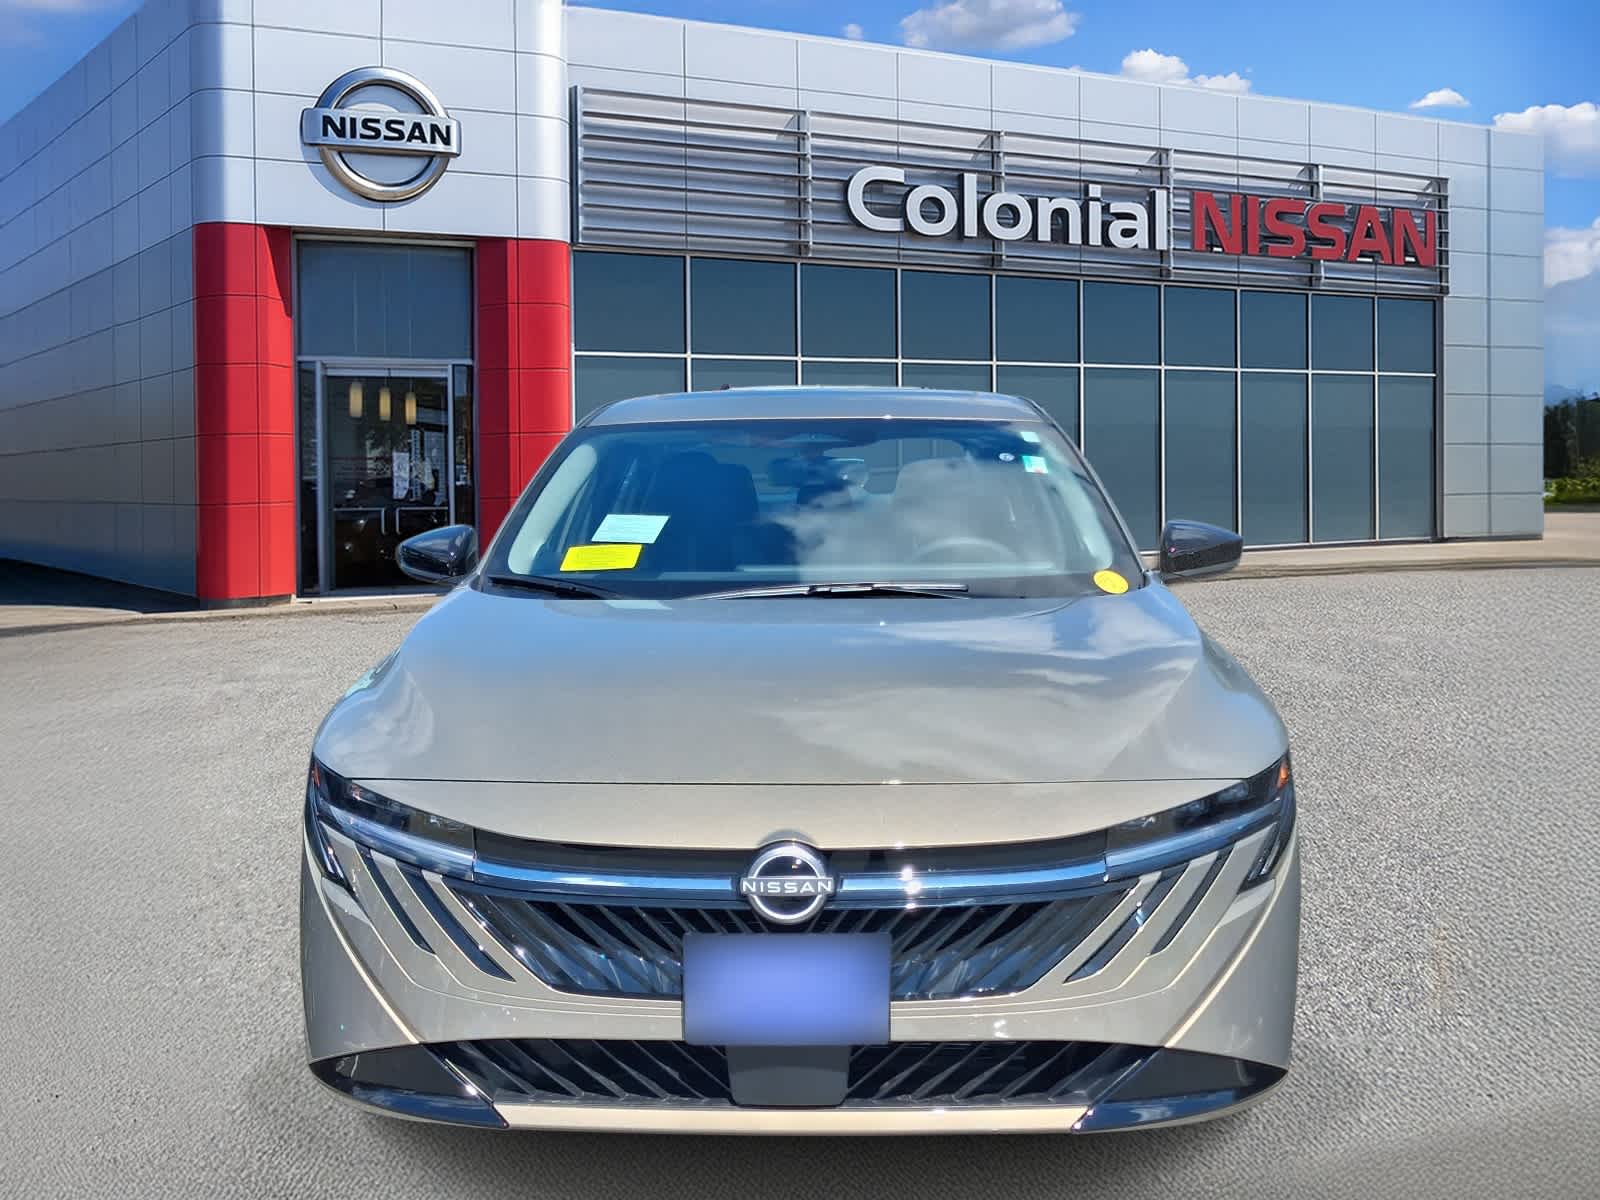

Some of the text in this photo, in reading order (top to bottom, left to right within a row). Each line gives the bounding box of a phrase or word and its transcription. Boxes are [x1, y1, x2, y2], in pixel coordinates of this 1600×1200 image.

[322, 115, 451, 146] NISSAN
[847, 165, 1437, 267] Colonial NISSAN
[742, 880, 832, 894] NISSAN
